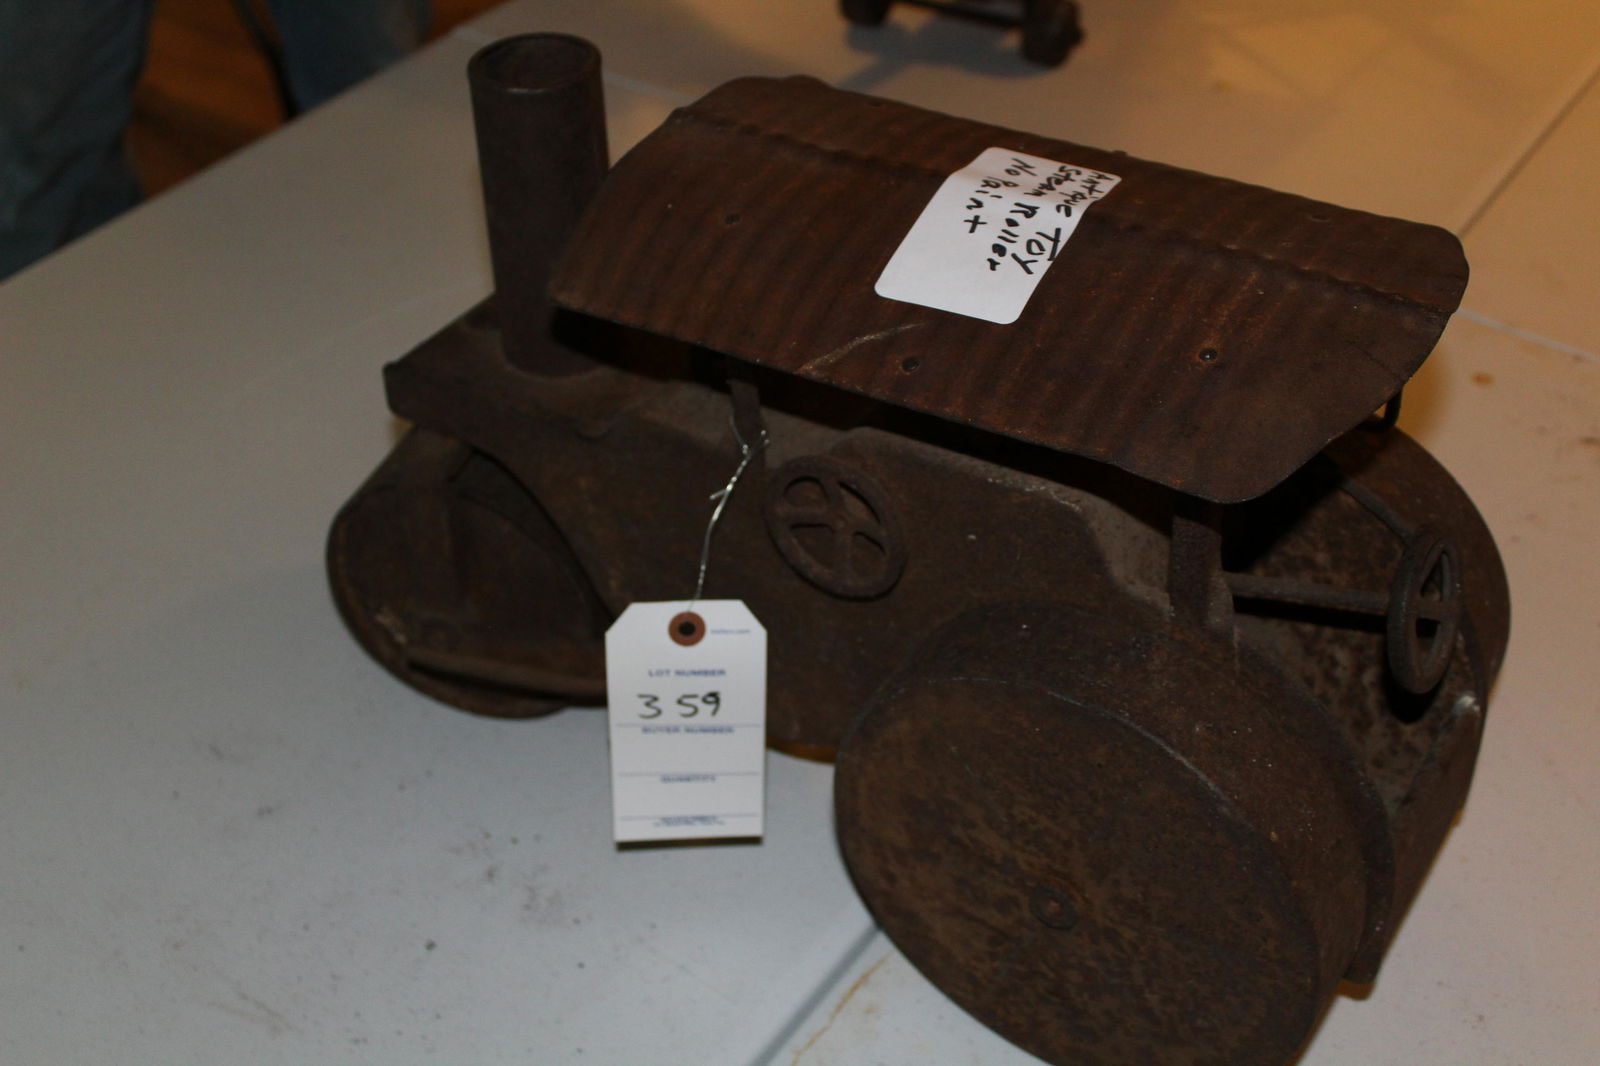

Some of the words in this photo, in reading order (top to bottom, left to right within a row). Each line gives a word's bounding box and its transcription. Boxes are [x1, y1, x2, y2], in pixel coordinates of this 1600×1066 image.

[1005, 157, 1037, 177] No
[648, 669, 671, 677] LOT
[675, 669, 726, 677] NUMBER
